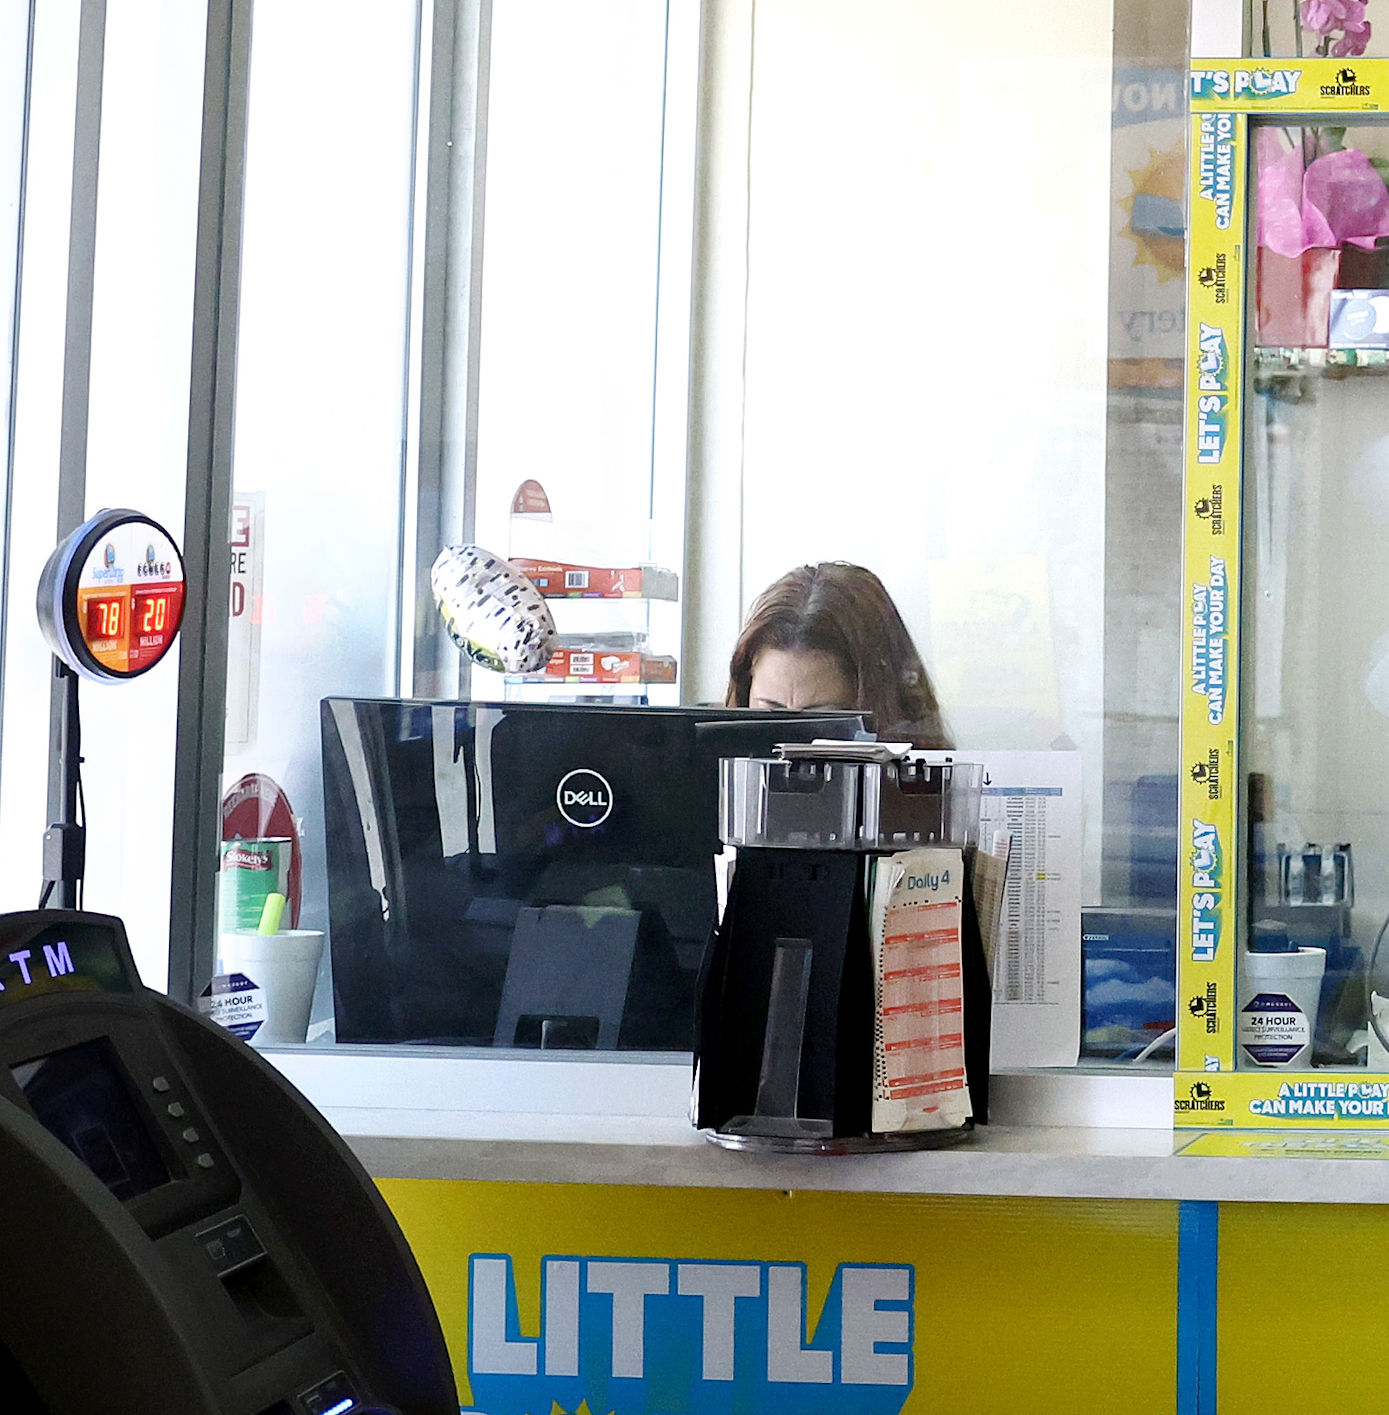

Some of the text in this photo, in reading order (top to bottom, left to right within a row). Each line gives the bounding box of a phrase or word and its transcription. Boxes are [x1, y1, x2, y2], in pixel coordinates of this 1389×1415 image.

[1320, 85, 1371, 98] SCRATCHERS
[1215, 253, 1226, 304] SCRATCHERS
[1198, 321, 1224, 464] LET'S PLAY
[99, 602, 120, 636] 78
[143, 598, 167, 632] 20
[563, 789, 608, 806] DELL
[907, 869, 951, 892] Daily 4
[0, 940, 76, 991] TM
[1251, 1016, 1297, 1026] 24 HOUR
[469, 1256, 914, 1384] LITTLE
